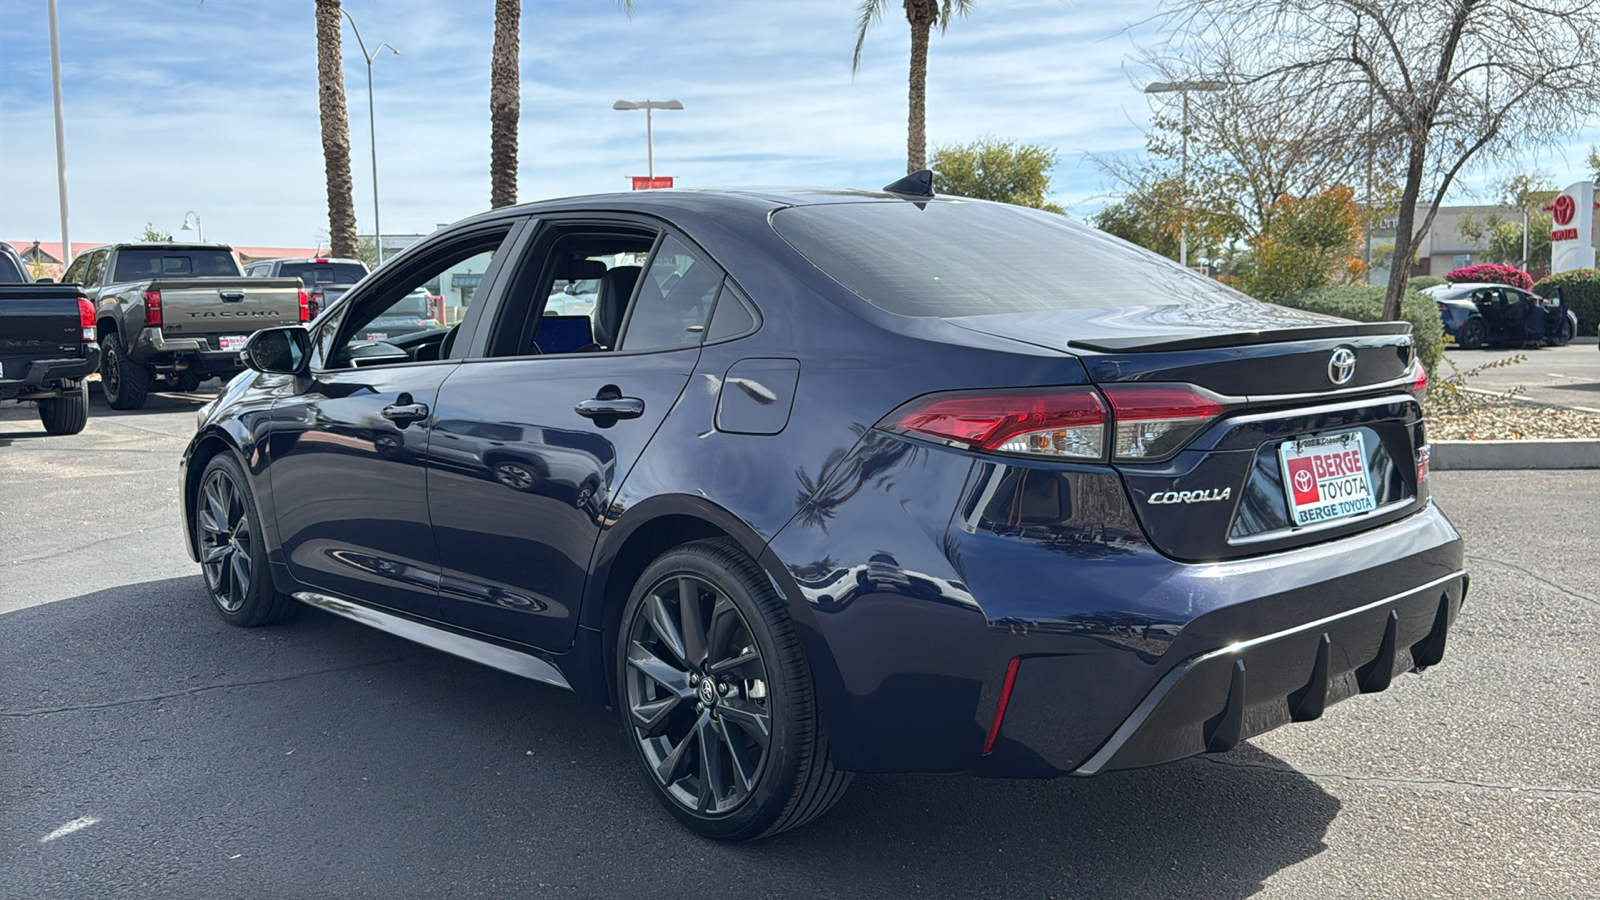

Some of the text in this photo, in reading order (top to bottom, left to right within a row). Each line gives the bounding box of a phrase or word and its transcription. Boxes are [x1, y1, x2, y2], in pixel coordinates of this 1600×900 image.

[186, 310, 280, 318] TACOMA
[1313, 450, 1362, 479] BERGE
[1147, 486, 1231, 504] COROLLA
[1319, 477, 1367, 500] TOYOTA
[1299, 497, 1373, 522] BERGE TOYOTA
